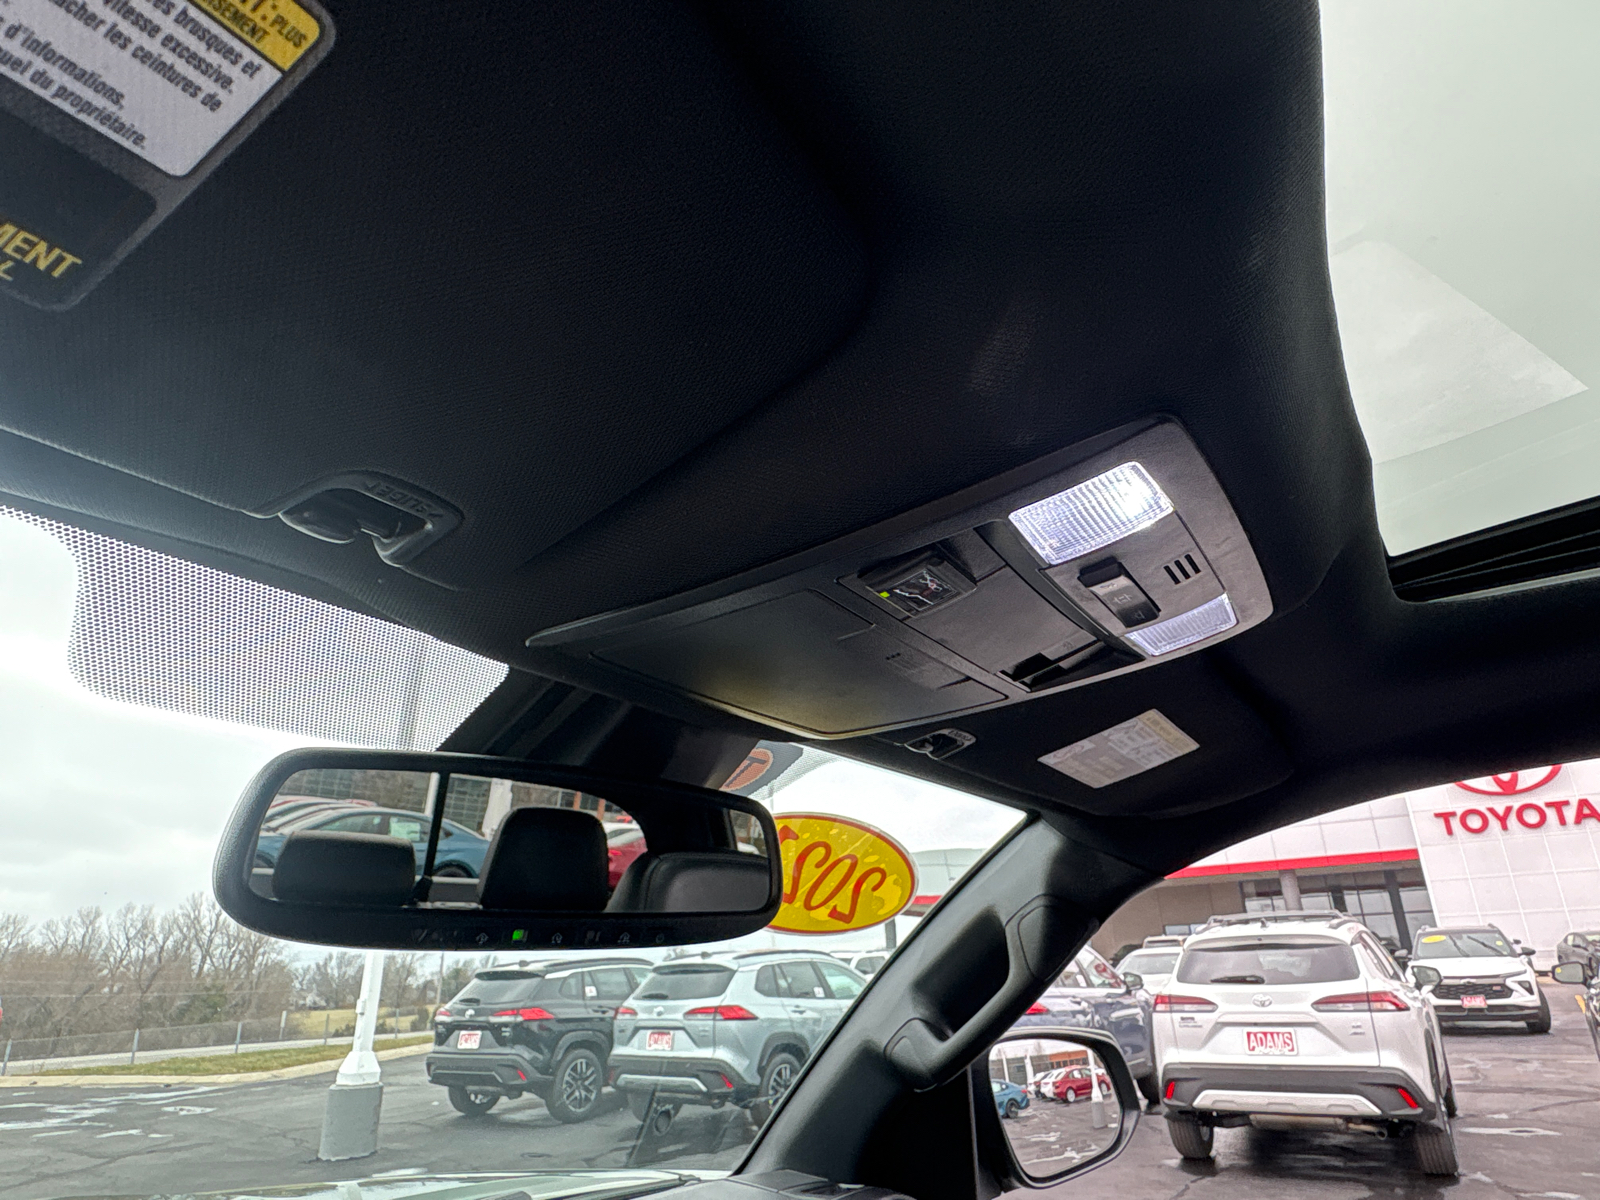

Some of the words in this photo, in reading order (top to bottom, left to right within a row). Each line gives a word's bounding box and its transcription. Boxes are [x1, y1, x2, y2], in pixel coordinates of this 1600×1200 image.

[174, 6, 243, 65] brusques
[241, 61, 262, 79] et
[269, 14, 308, 48] PLUS
[104, 22, 132, 50] les
[132, 45, 202, 98] ceintures
[201, 92, 222, 112] de
[161, 34, 233, 94] excessive.
[0, 47, 32, 75] uel
[29, 68, 54, 90] du
[50, 84, 146, 149] propriétaire.
[1434, 798, 1600, 836] TOYOTA
[1248, 1031, 1294, 1052] ADAMS
